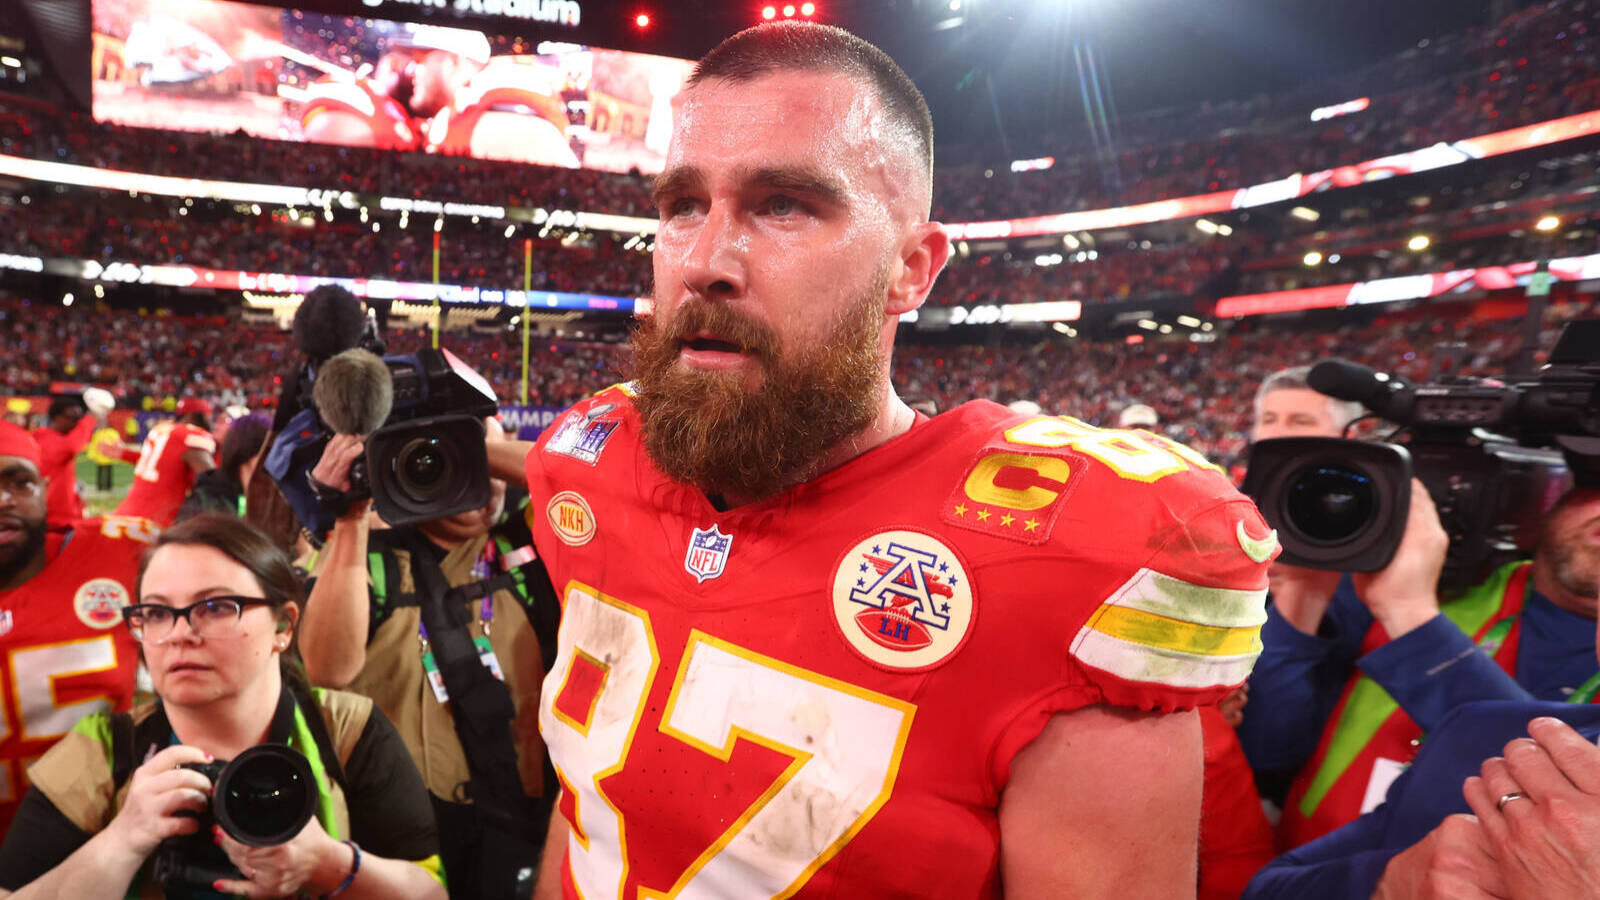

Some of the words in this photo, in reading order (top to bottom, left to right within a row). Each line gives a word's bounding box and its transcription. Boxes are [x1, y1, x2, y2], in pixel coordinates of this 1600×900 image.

[964, 453, 1071, 511] C
[559, 504, 585, 532] NKH
[690, 548, 719, 573] NFL
[849, 542, 950, 631] A
[877, 617, 911, 642] LH
[538, 579, 918, 900] 87
